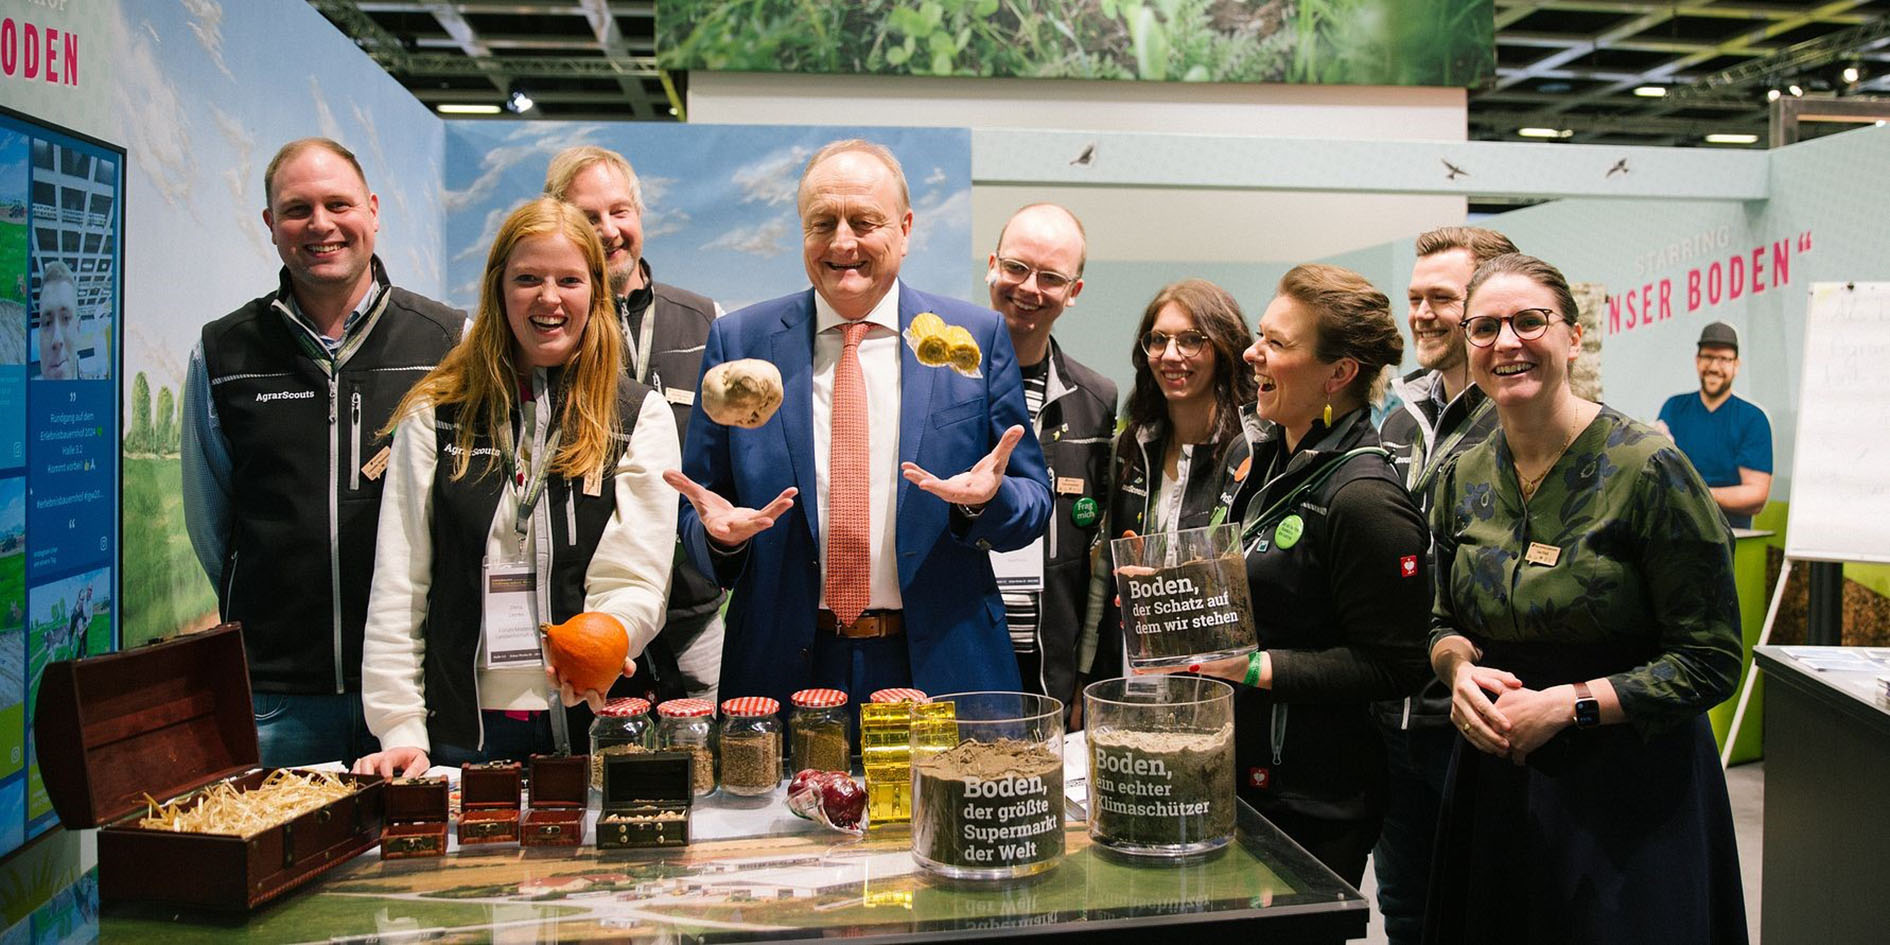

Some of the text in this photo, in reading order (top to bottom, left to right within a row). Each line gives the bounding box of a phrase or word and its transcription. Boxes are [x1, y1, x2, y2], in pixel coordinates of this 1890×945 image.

[1, 17, 78, 87] ODEN
[1637, 224, 1730, 275] STARRING
[255, 390, 315, 403] AgrarScouts
[444, 443, 501, 457] AgrScouts
[1076, 511, 1095, 520] mich
[1077, 502, 1093, 511] Frag
[1128, 576, 1200, 599] Boden,
[1132, 591, 1230, 617] der Schatz auf
[1135, 611, 1239, 635] dem wir stehen
[1095, 748, 1173, 780] Boden,
[963, 774, 1048, 799] Boden,
[1096, 776, 1172, 796] ein echter
[963, 799, 1049, 822] der größte
[1097, 794, 1210, 817] Klimaschützer
[963, 814, 1057, 844] Supermarkt
[964, 841, 1037, 861] der Welt
